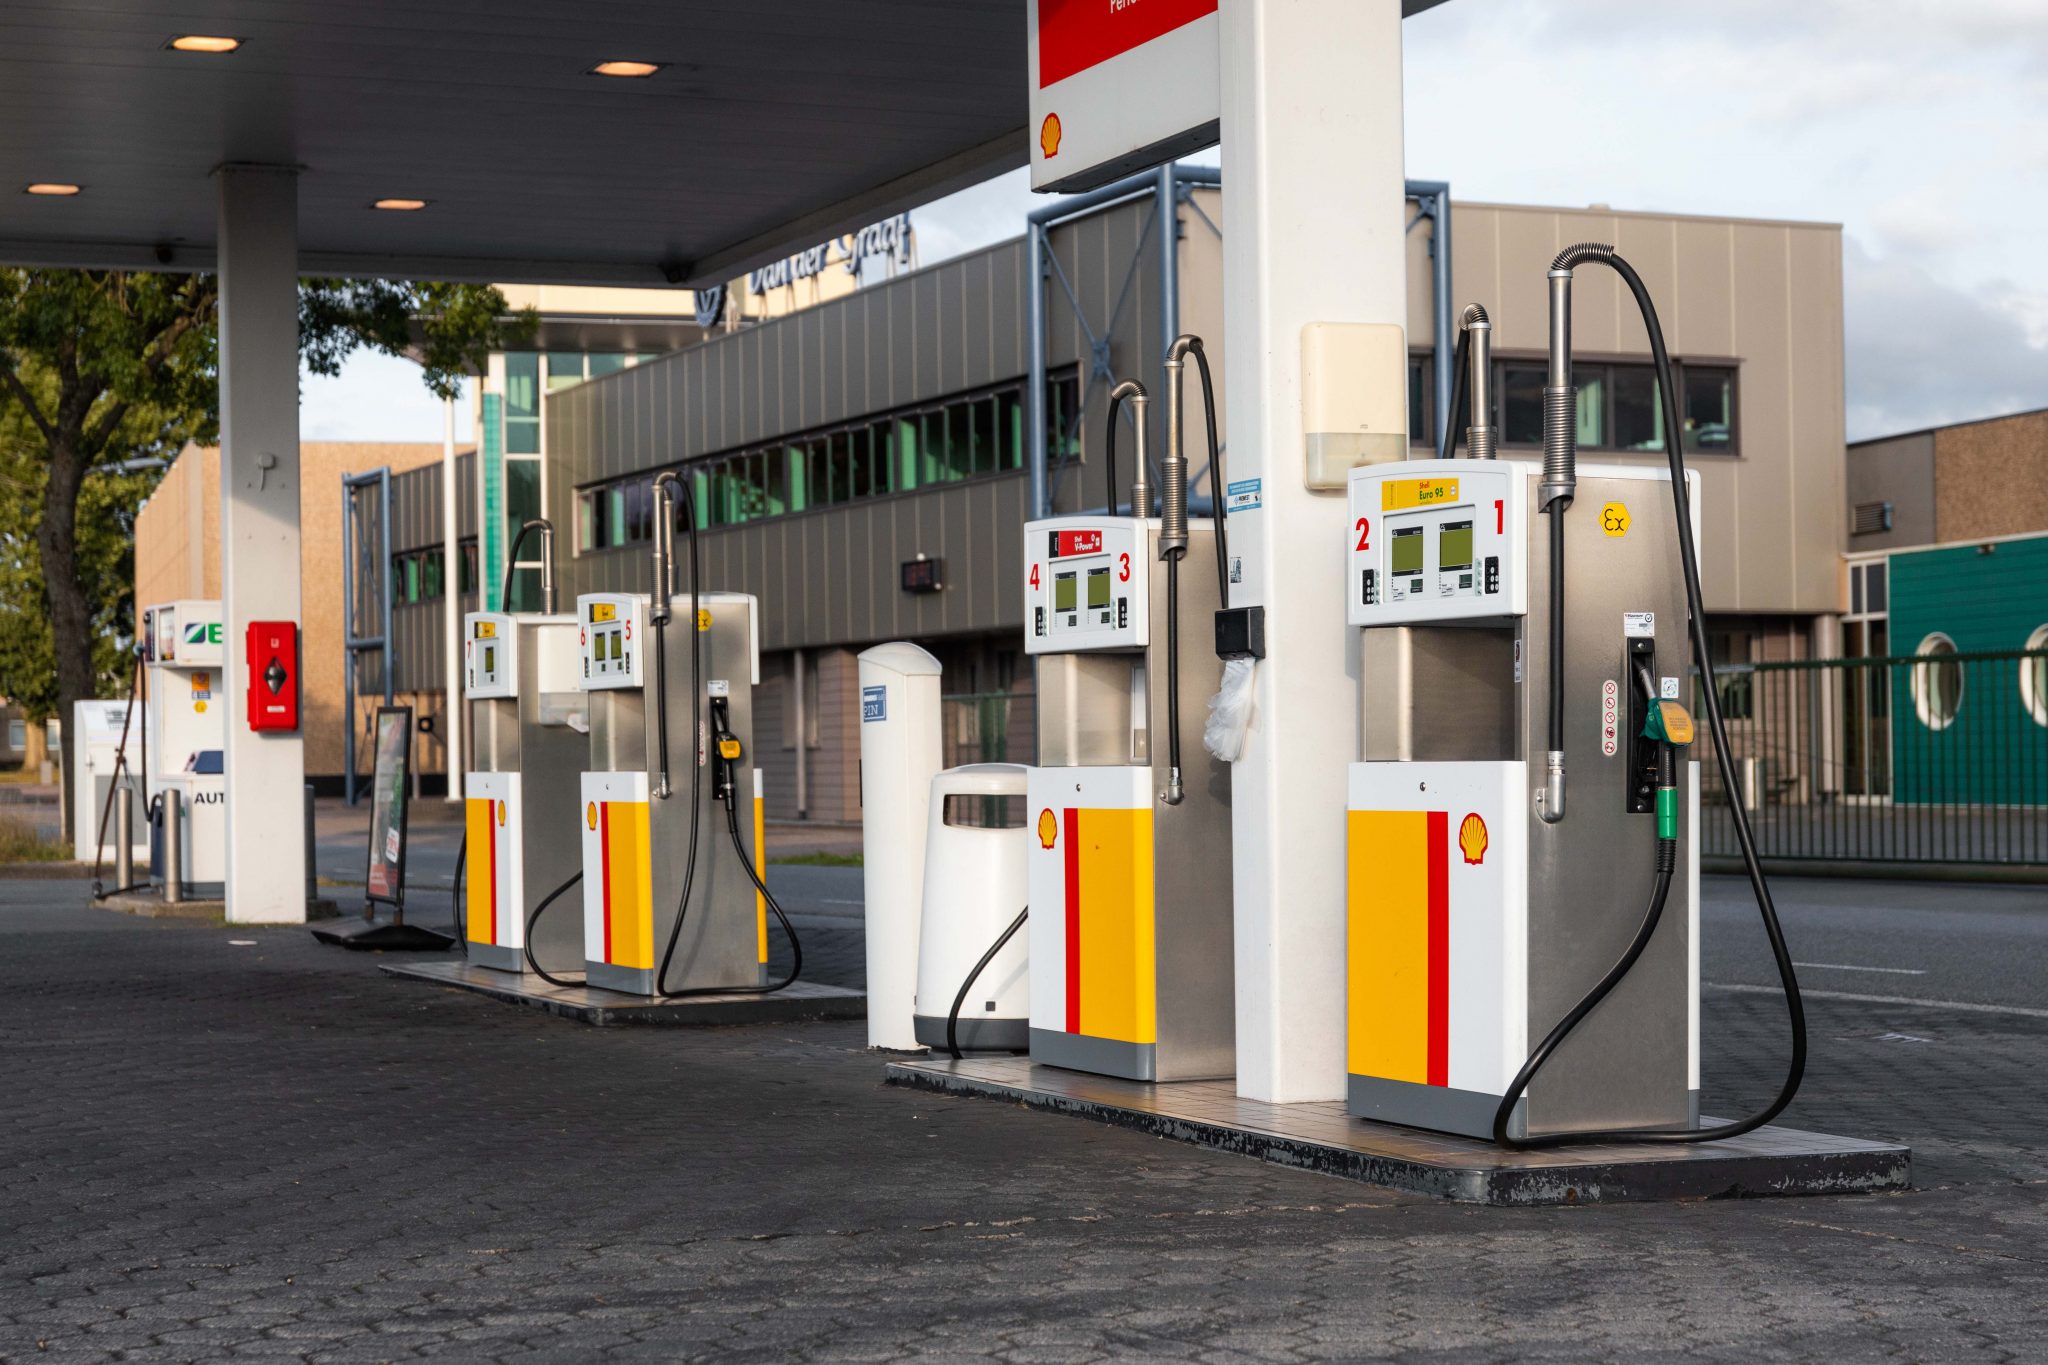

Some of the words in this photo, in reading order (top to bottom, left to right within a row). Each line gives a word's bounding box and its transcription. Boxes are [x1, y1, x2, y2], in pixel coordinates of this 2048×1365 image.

[1419, 490, 1434, 500] Euro
[1434, 487, 1444, 498] 95
[1494, 499, 1504, 535] 1
[1355, 517, 1370, 551] 2
[1074, 542, 1094, 552] V-Power
[1029, 563, 1040, 591] 4
[1119, 552, 1130, 582] 3
[580, 625, 586, 646] 6
[626, 619, 632, 640] 5
[467, 640, 472, 659] 7
